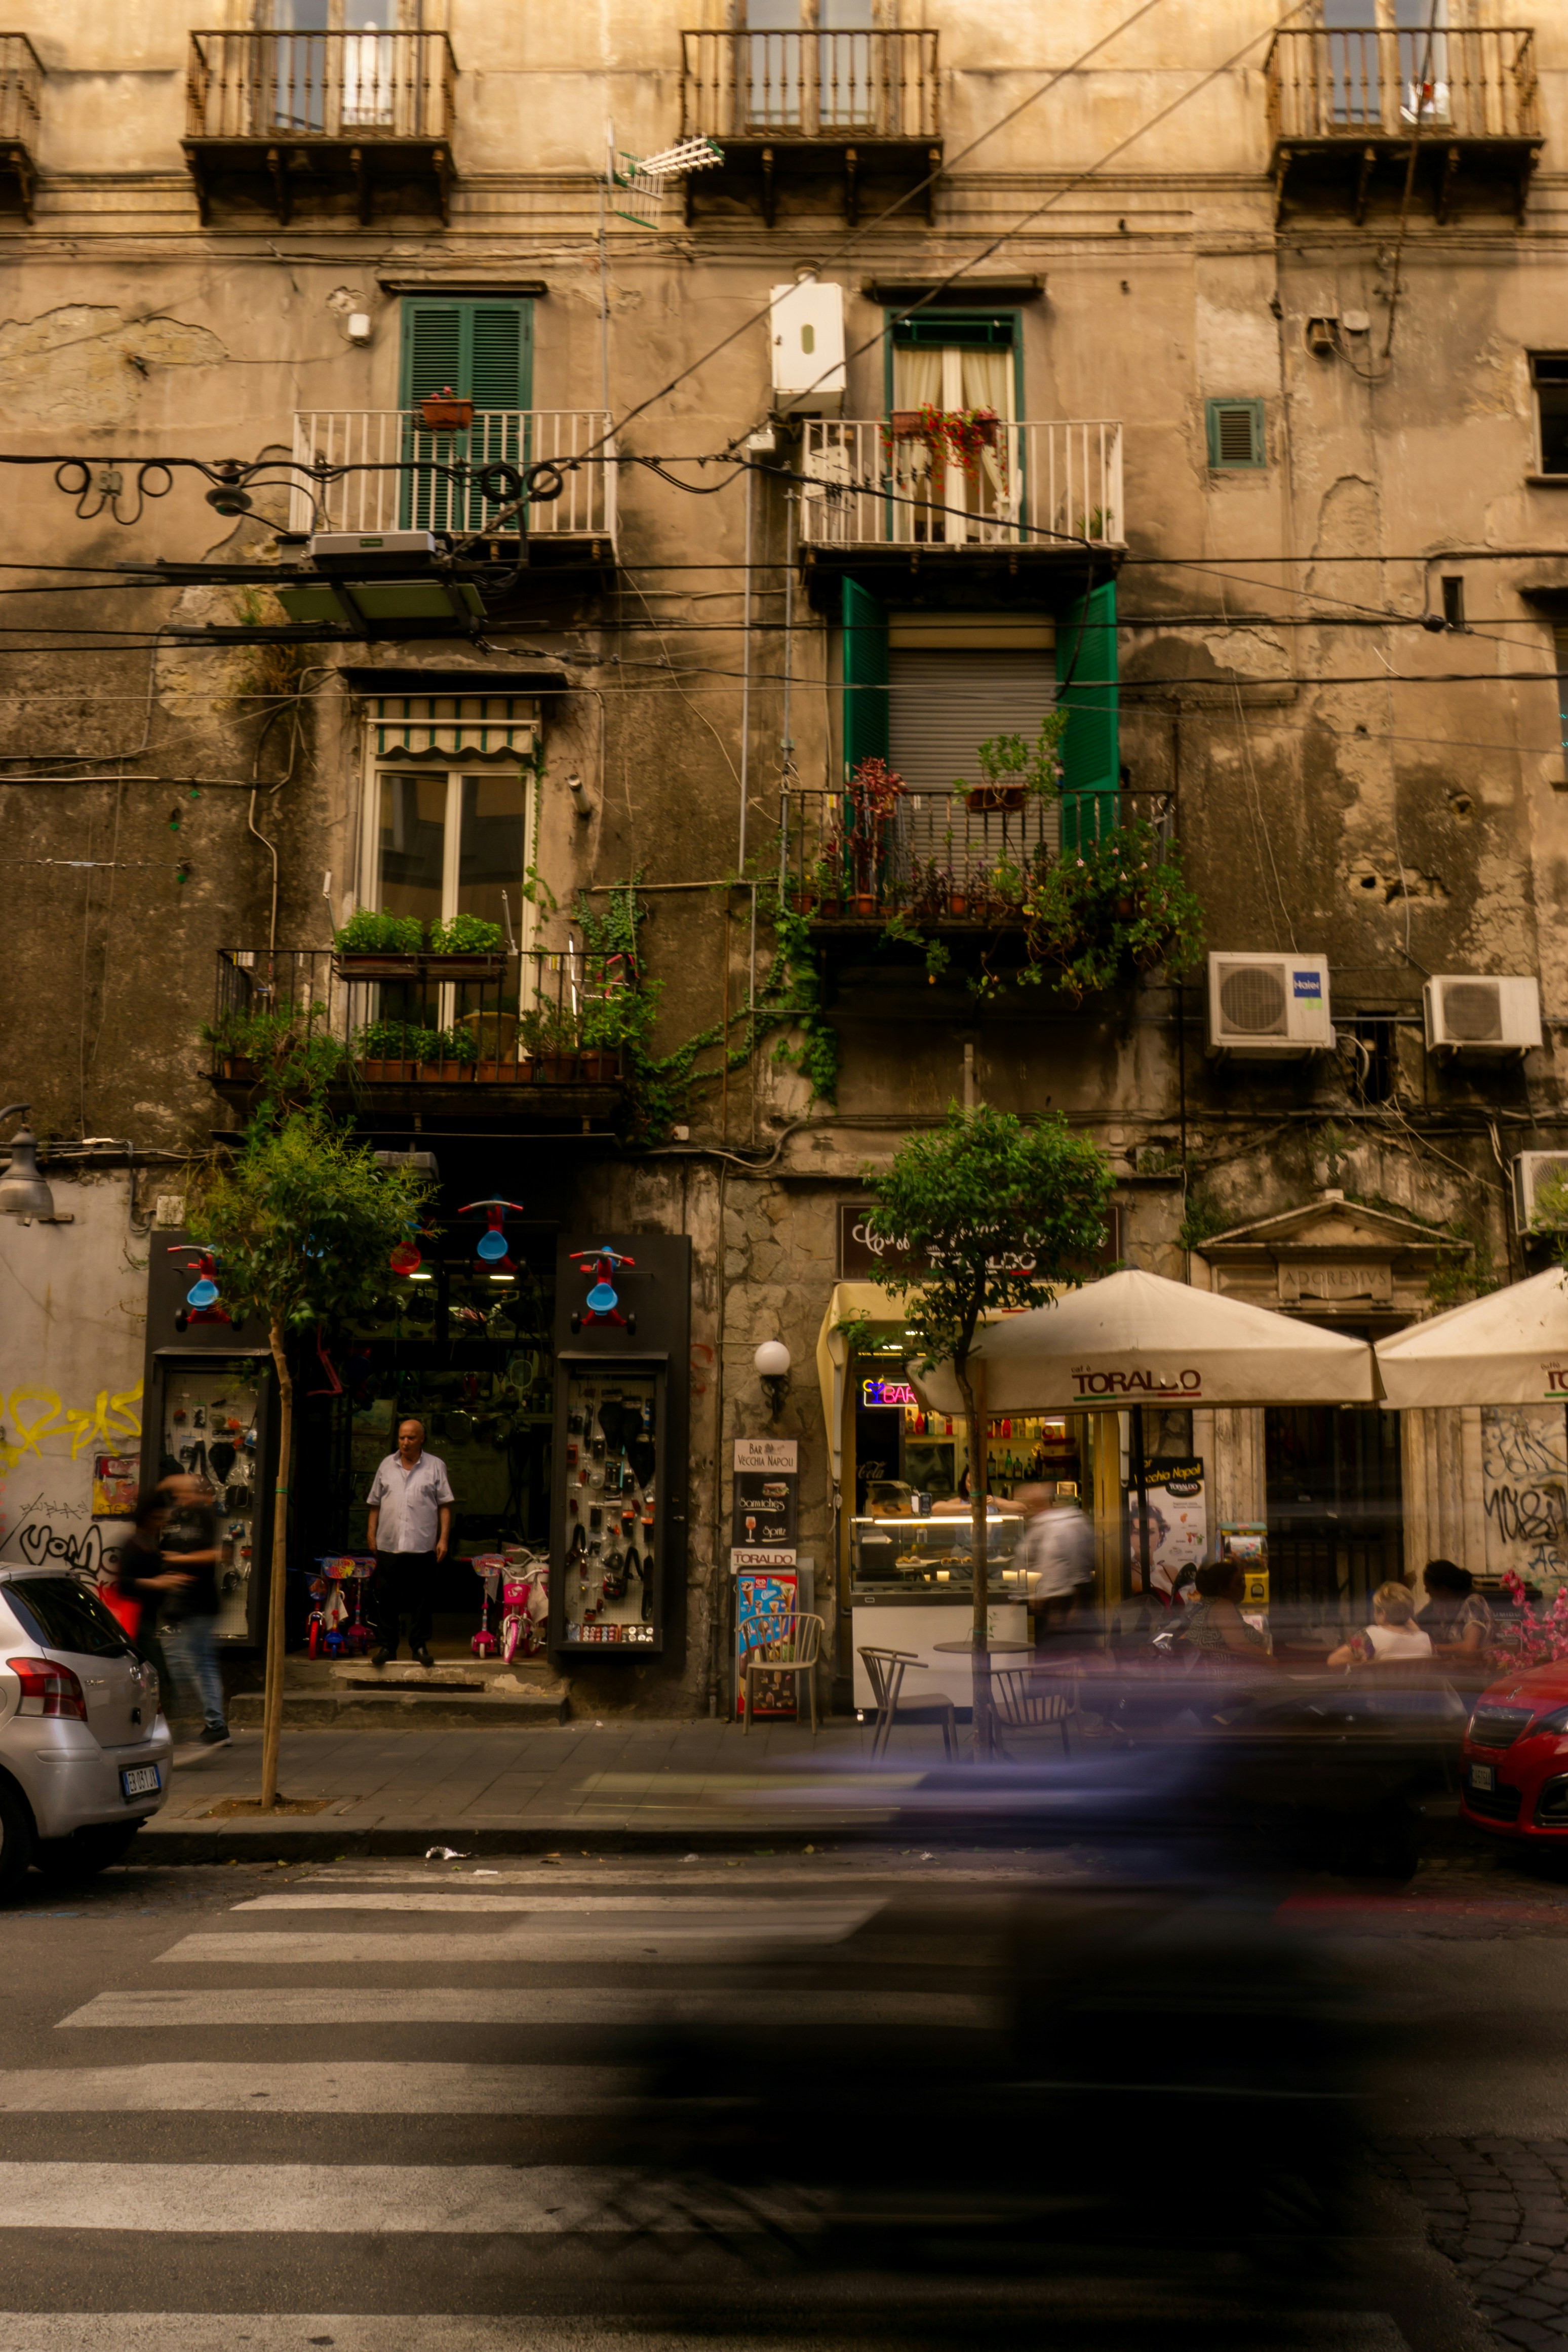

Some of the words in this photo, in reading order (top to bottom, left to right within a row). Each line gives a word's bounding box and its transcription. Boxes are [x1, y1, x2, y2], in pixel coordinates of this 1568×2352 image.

[1283, 1271, 1387, 1286] ADOREMVS
[750, 1443, 762, 1455] BAR
[738, 1455, 765, 1466] VECCHIA
[768, 1455, 793, 1467] NAPOLI
[1173, 1463, 1201, 1480] Napoli
[762, 1525, 786, 1538] Spritz
[734, 1554, 793, 1564] TORALDO
